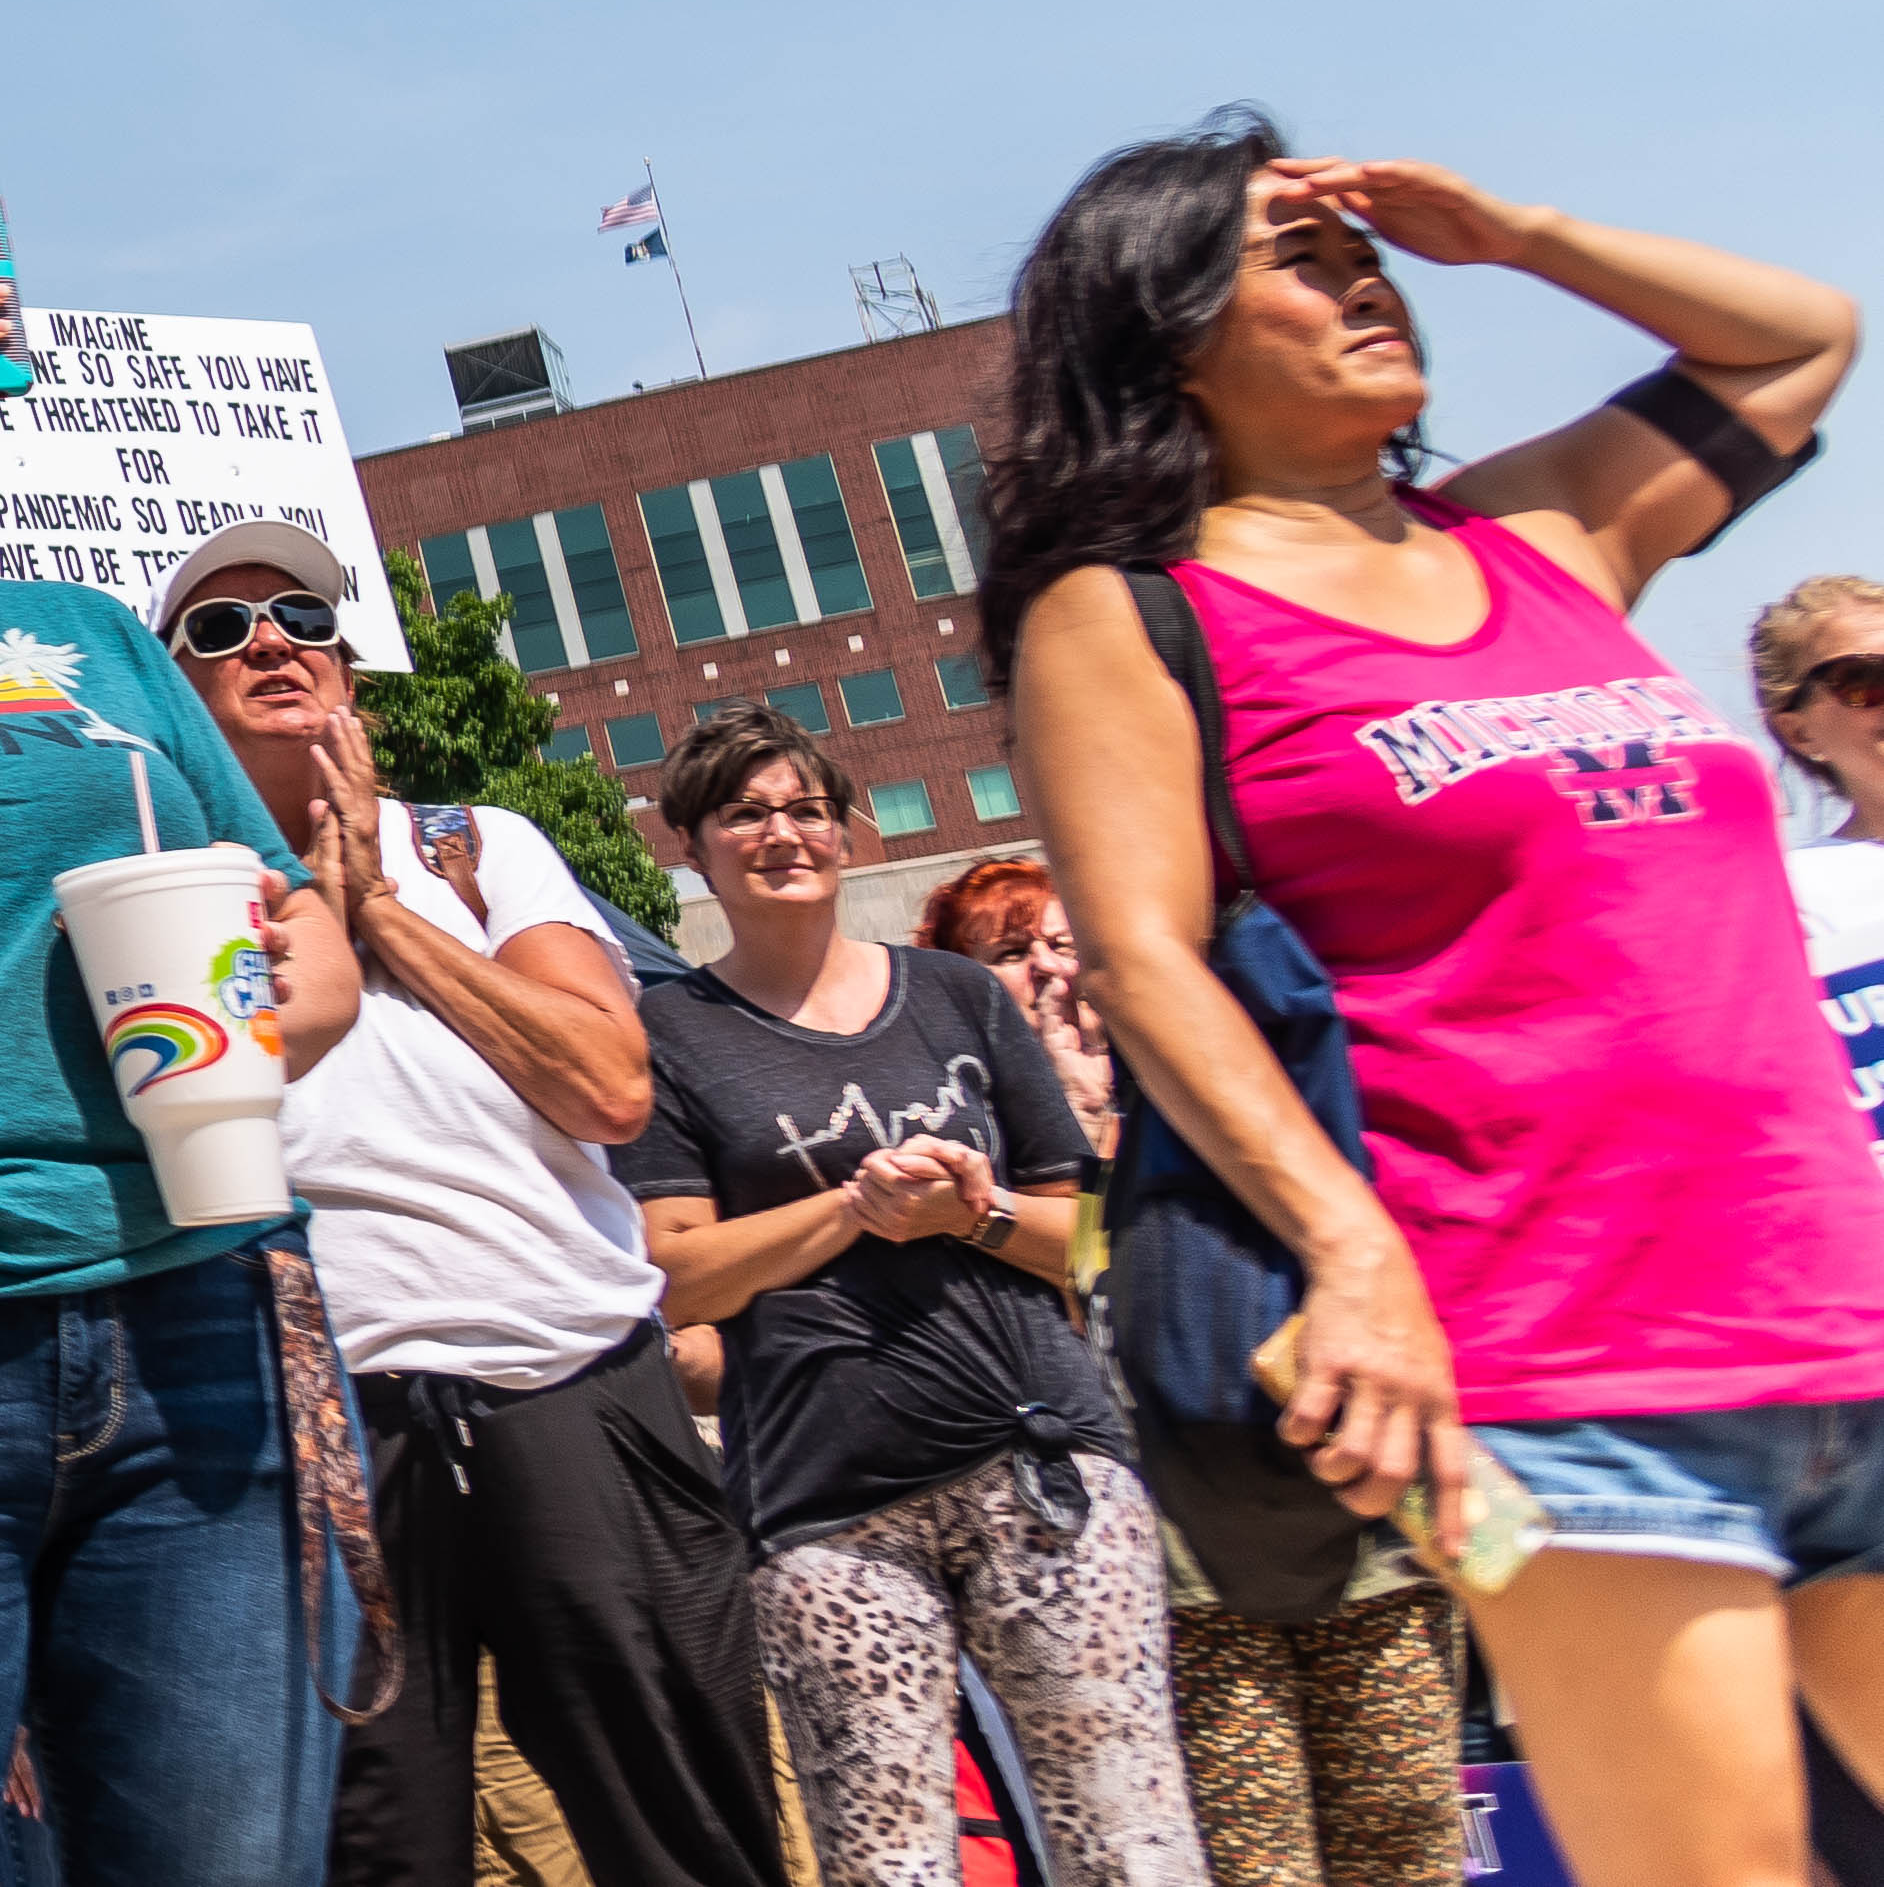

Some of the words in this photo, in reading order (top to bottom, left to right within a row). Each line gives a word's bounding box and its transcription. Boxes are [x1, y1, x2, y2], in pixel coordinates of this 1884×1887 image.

[48, 313, 153, 352] IMAGiNE
[30, 349, 67, 385] NE
[78, 350, 114, 387] SO
[126, 354, 192, 390] SAFE
[197, 354, 251, 391] YOU
[256, 356, 318, 394] HAVE
[23, 396, 181, 433] THREATENED
[185, 399, 221, 437] TO
[226, 401, 293, 441] TAKE
[115, 447, 171, 485] FOR
[131, 496, 168, 535] SO
[47, 544, 84, 583] TO
[89, 546, 126, 586] BE
